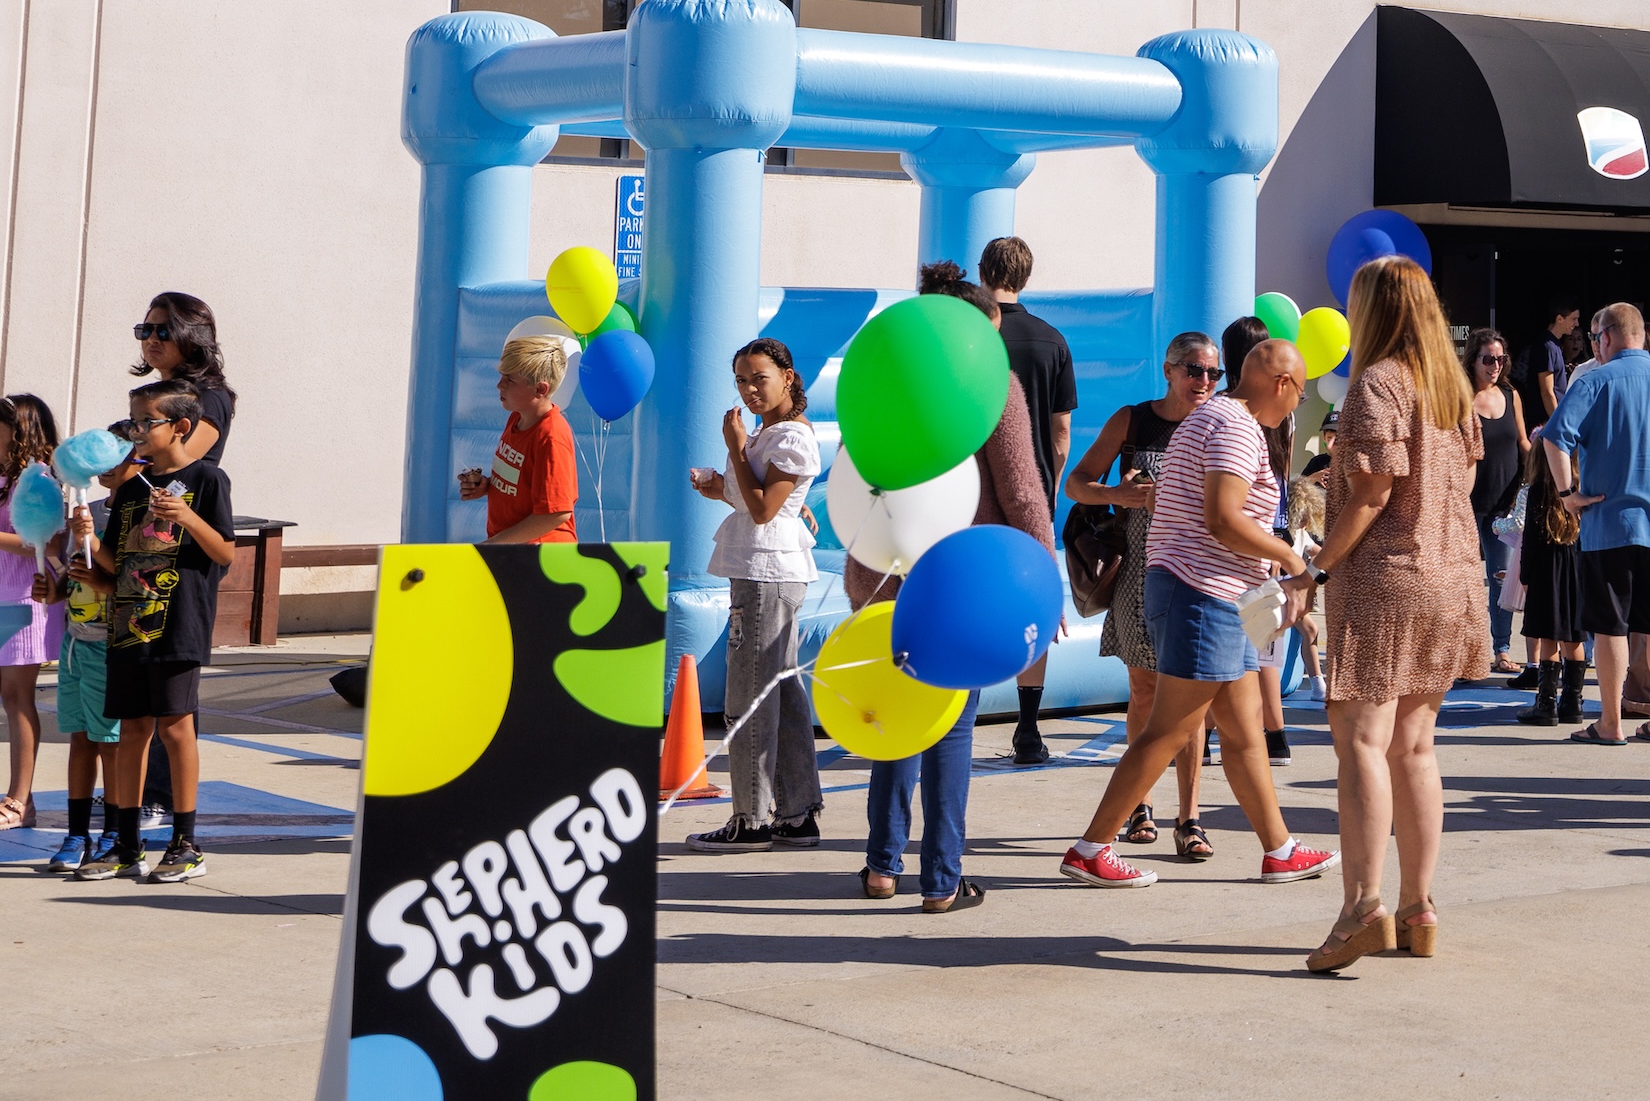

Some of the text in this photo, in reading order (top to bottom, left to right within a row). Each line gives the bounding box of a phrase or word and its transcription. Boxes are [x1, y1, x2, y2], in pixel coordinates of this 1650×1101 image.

[627, 234, 641, 249] ON
[618, 267, 636, 278] FINE
[1450, 325, 1470, 341] TIMES
